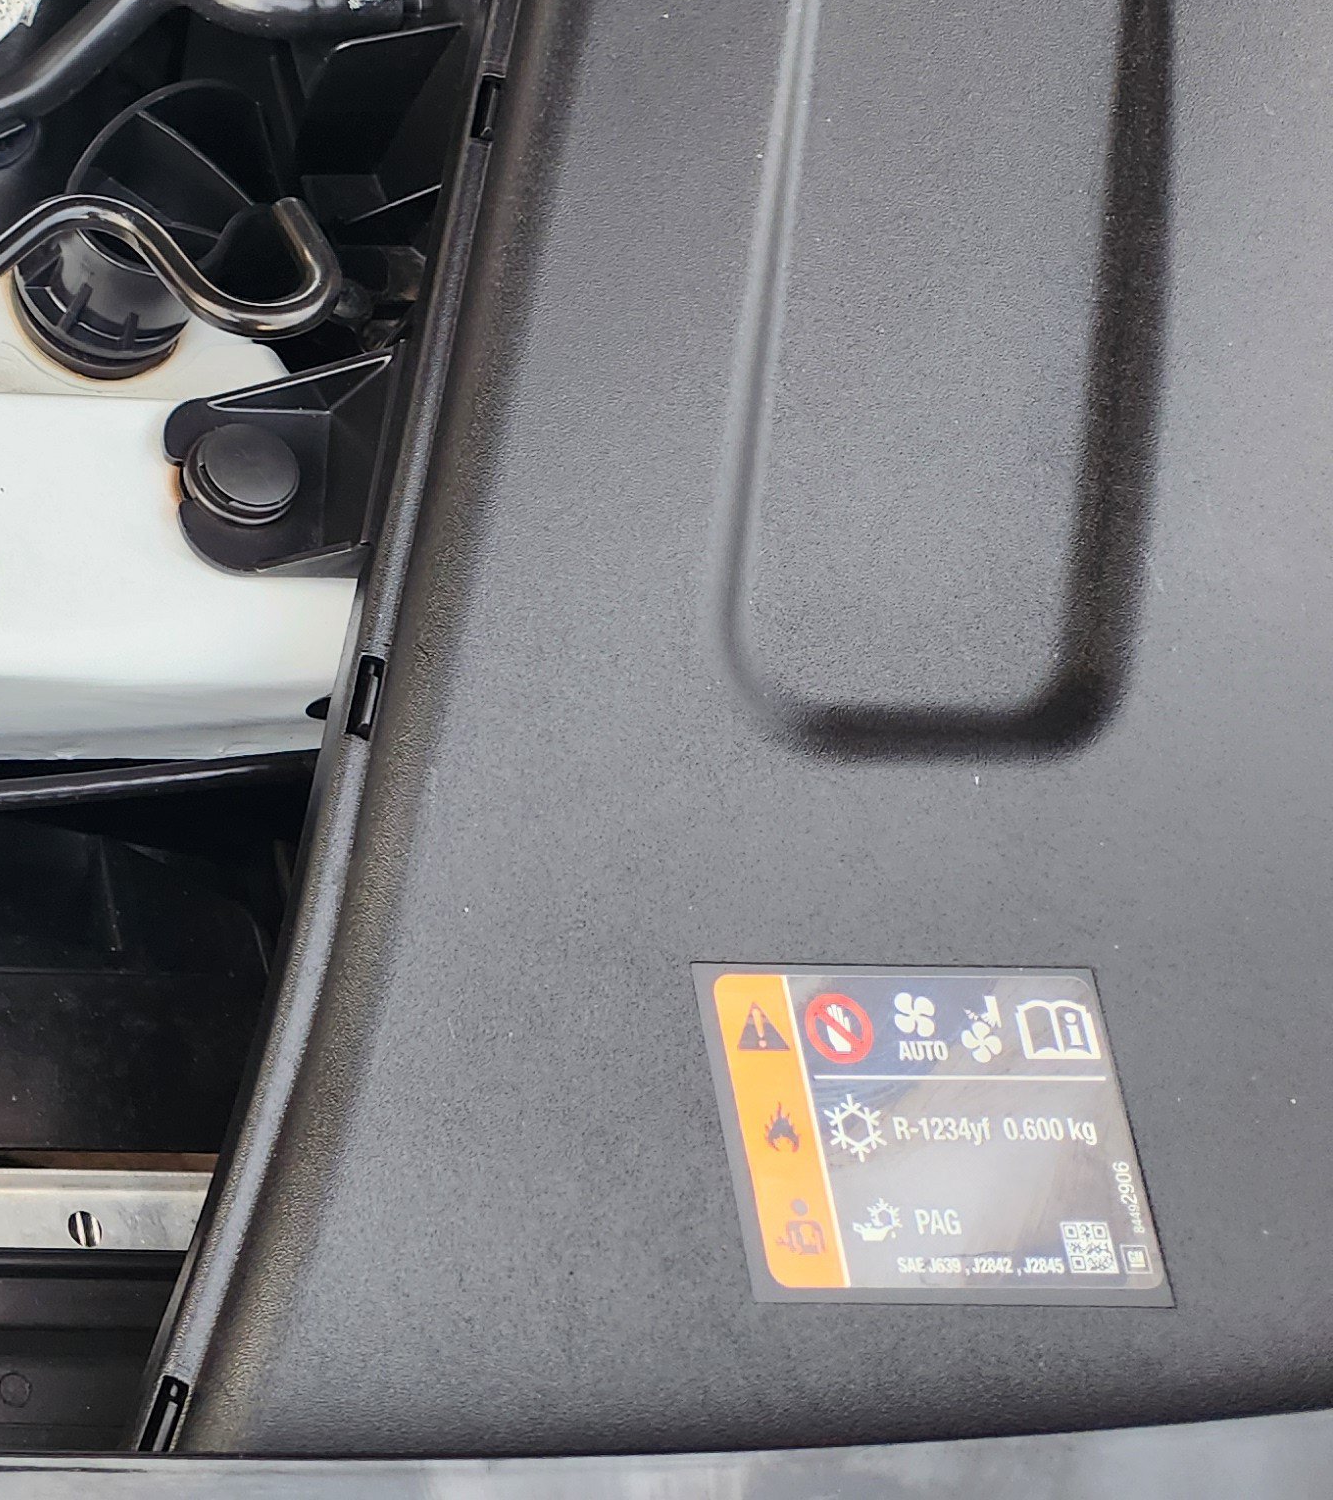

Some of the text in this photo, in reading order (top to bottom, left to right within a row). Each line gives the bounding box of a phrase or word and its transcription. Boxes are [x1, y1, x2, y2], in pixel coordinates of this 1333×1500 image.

[898, 1040, 949, 1062] AUTO
[892, 1116, 1098, 1146] R-1234yf 0.600 kg
[1112, 1161, 1145, 1233] 84492906
[915, 1208, 962, 1236] PAG
[896, 1256, 926, 1274] SAE
[928, 1256, 963, 1274] J639
